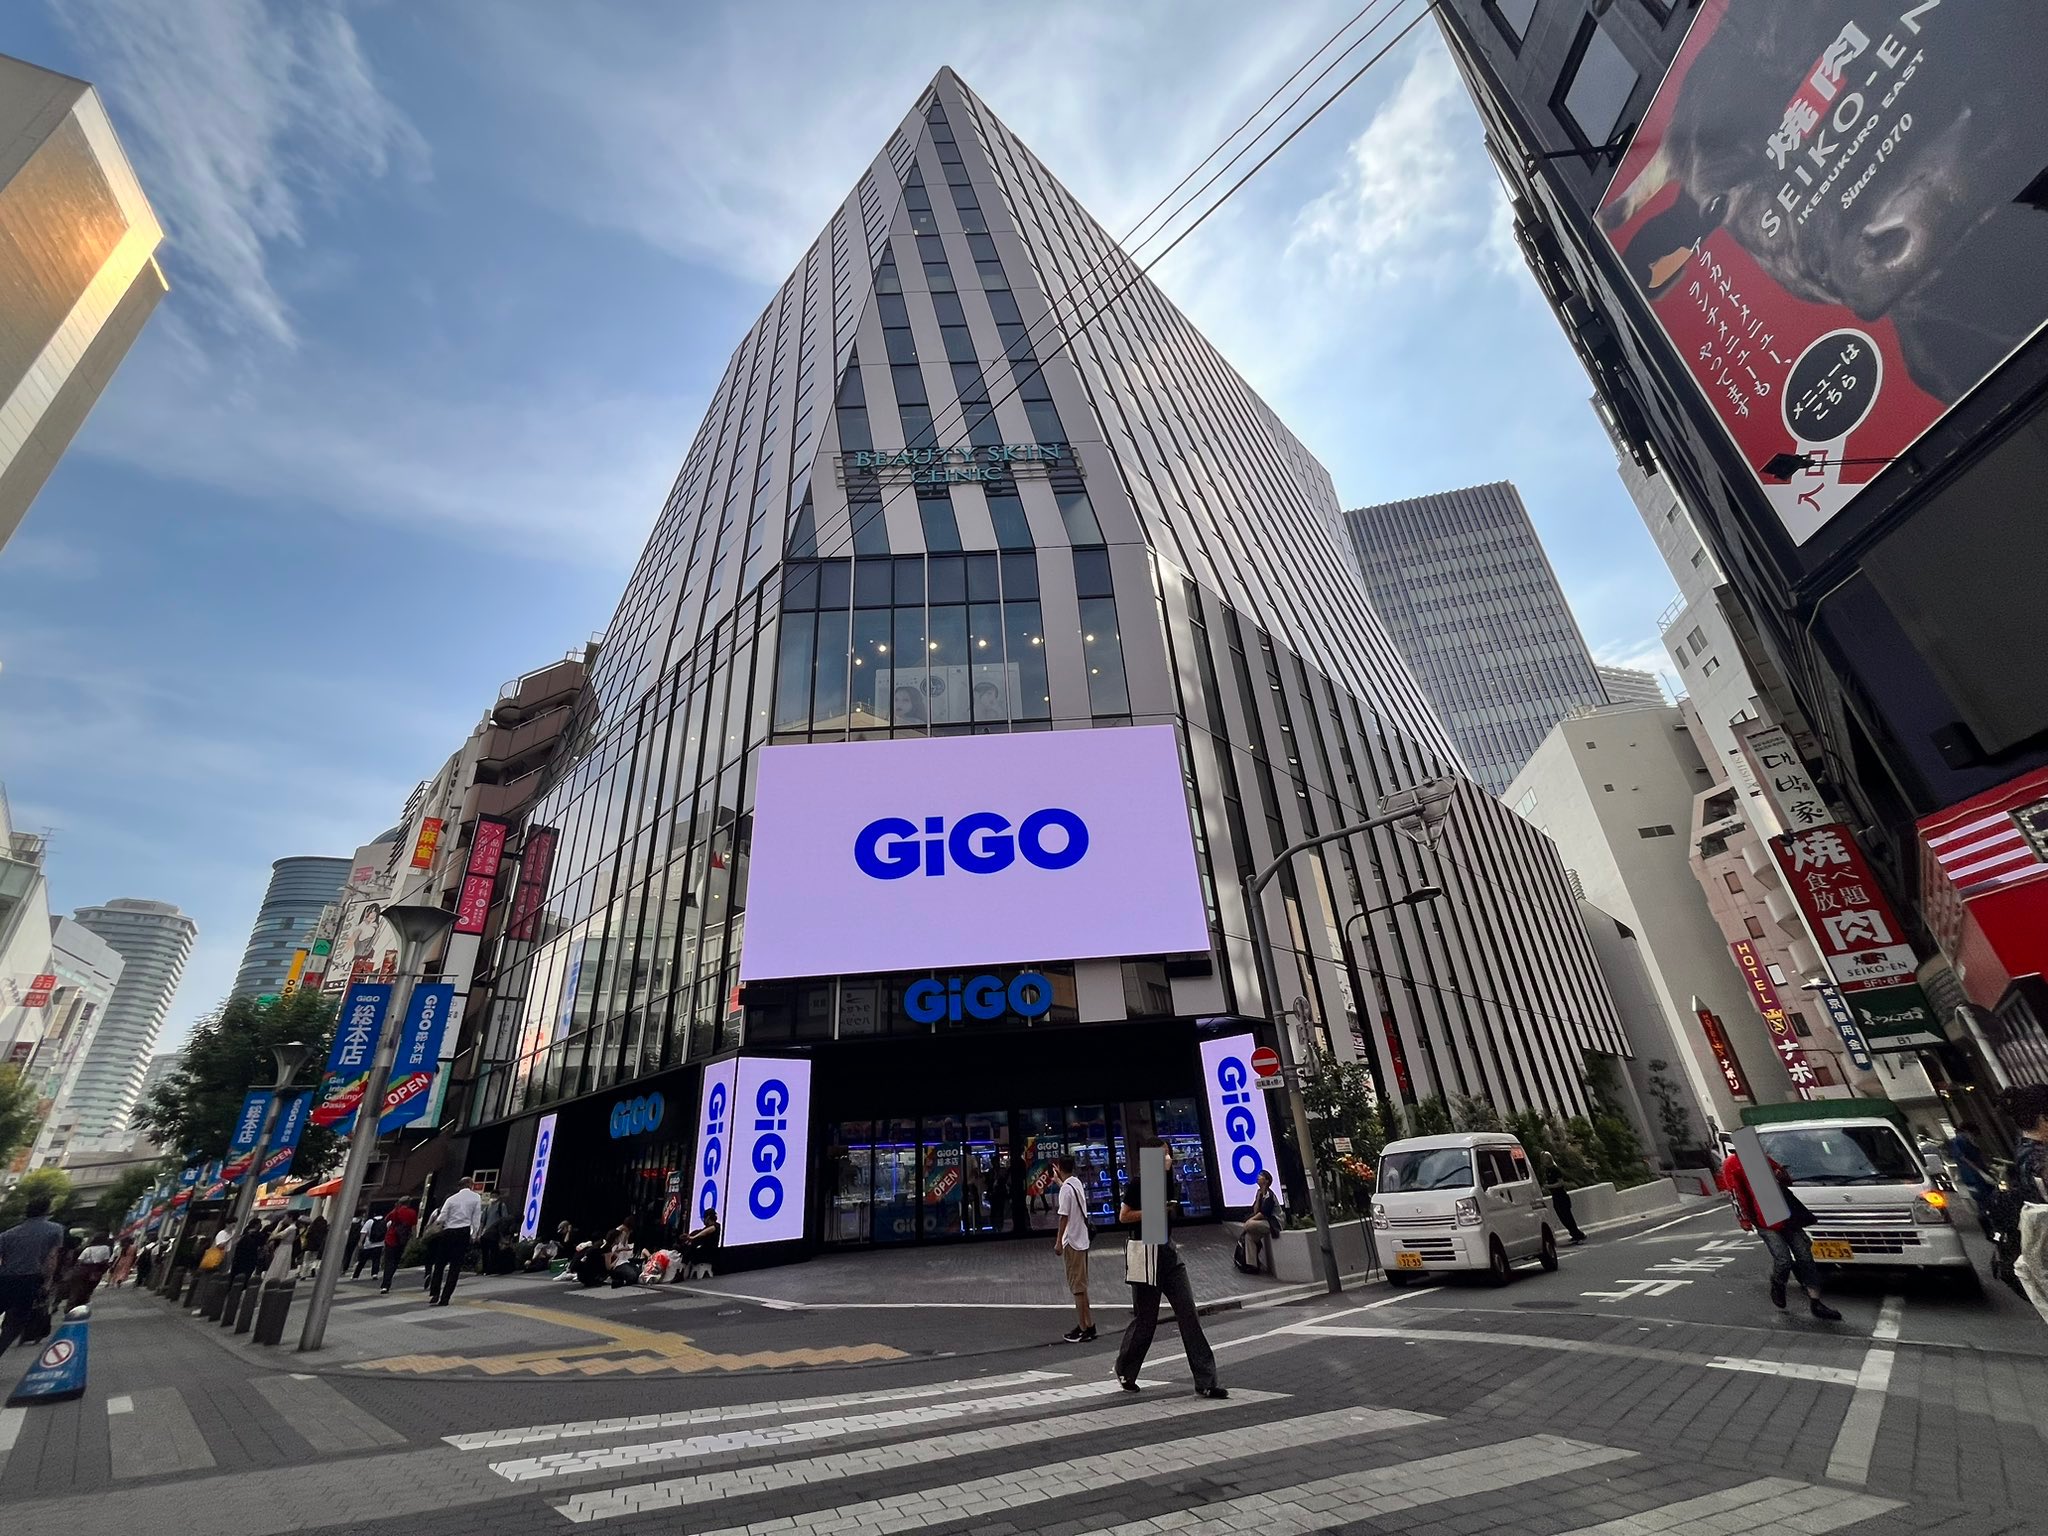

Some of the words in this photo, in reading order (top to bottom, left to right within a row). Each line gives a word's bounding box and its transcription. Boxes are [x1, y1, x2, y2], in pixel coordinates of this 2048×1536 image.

[1765, 21, 1870, 171] 焼肉
[1797, 114, 1879, 225] IKEBUKURO
[1881, 49, 1924, 109] EAST
[1841, 163, 1877, 209] Since
[1875, 113, 1913, 163] 1970
[1689, 281, 1770, 396] ランチメニューも
[1700, 342, 1749, 419] やってます
[1793, 343, 1860, 420] メニューは
[1813, 374, 1857, 420] こちら
[855, 446, 978, 467] BEAUTY
[987, 443, 1062, 462] SKIN
[911, 466, 1003, 484] CLINIC
[1798, 450, 1829, 512] 入口
[416, 831, 438, 859] 麻雀
[854, 808, 1089, 880] GiGO
[1784, 830, 1851, 872] 焼
[1804, 865, 1859, 892] 食べ
[1811, 884, 1870, 912] 放題
[1821, 909, 1893, 950] 肉
[1737, 943, 1772, 1003] HOTEL
[1847, 961, 1908, 977] SEIKO-EN
[904, 973, 1054, 1024] GiGO
[338, 1004, 376, 1065] 総本店
[1822, 988, 1869, 1064] 東京信用金庫
[387, 1074, 429, 1104] OPEN
[1720, 1058, 1740, 1090] ナポリ
[321, 1102, 346, 1110] Oasis
[610, 1092, 665, 1139] GiGO
[1217, 1057, 1263, 1185] GiGO
[266, 1149, 292, 1168] OPEN
[699, 1082, 726, 1224] GiGO
[748, 1079, 789, 1220] GiGO
[937, 1149, 959, 1158] GiGO
[1037, 1141, 1059, 1150] GiGO
[527, 1130, 549, 1230] GiGO
[934, 1170, 959, 1197] OPEN
